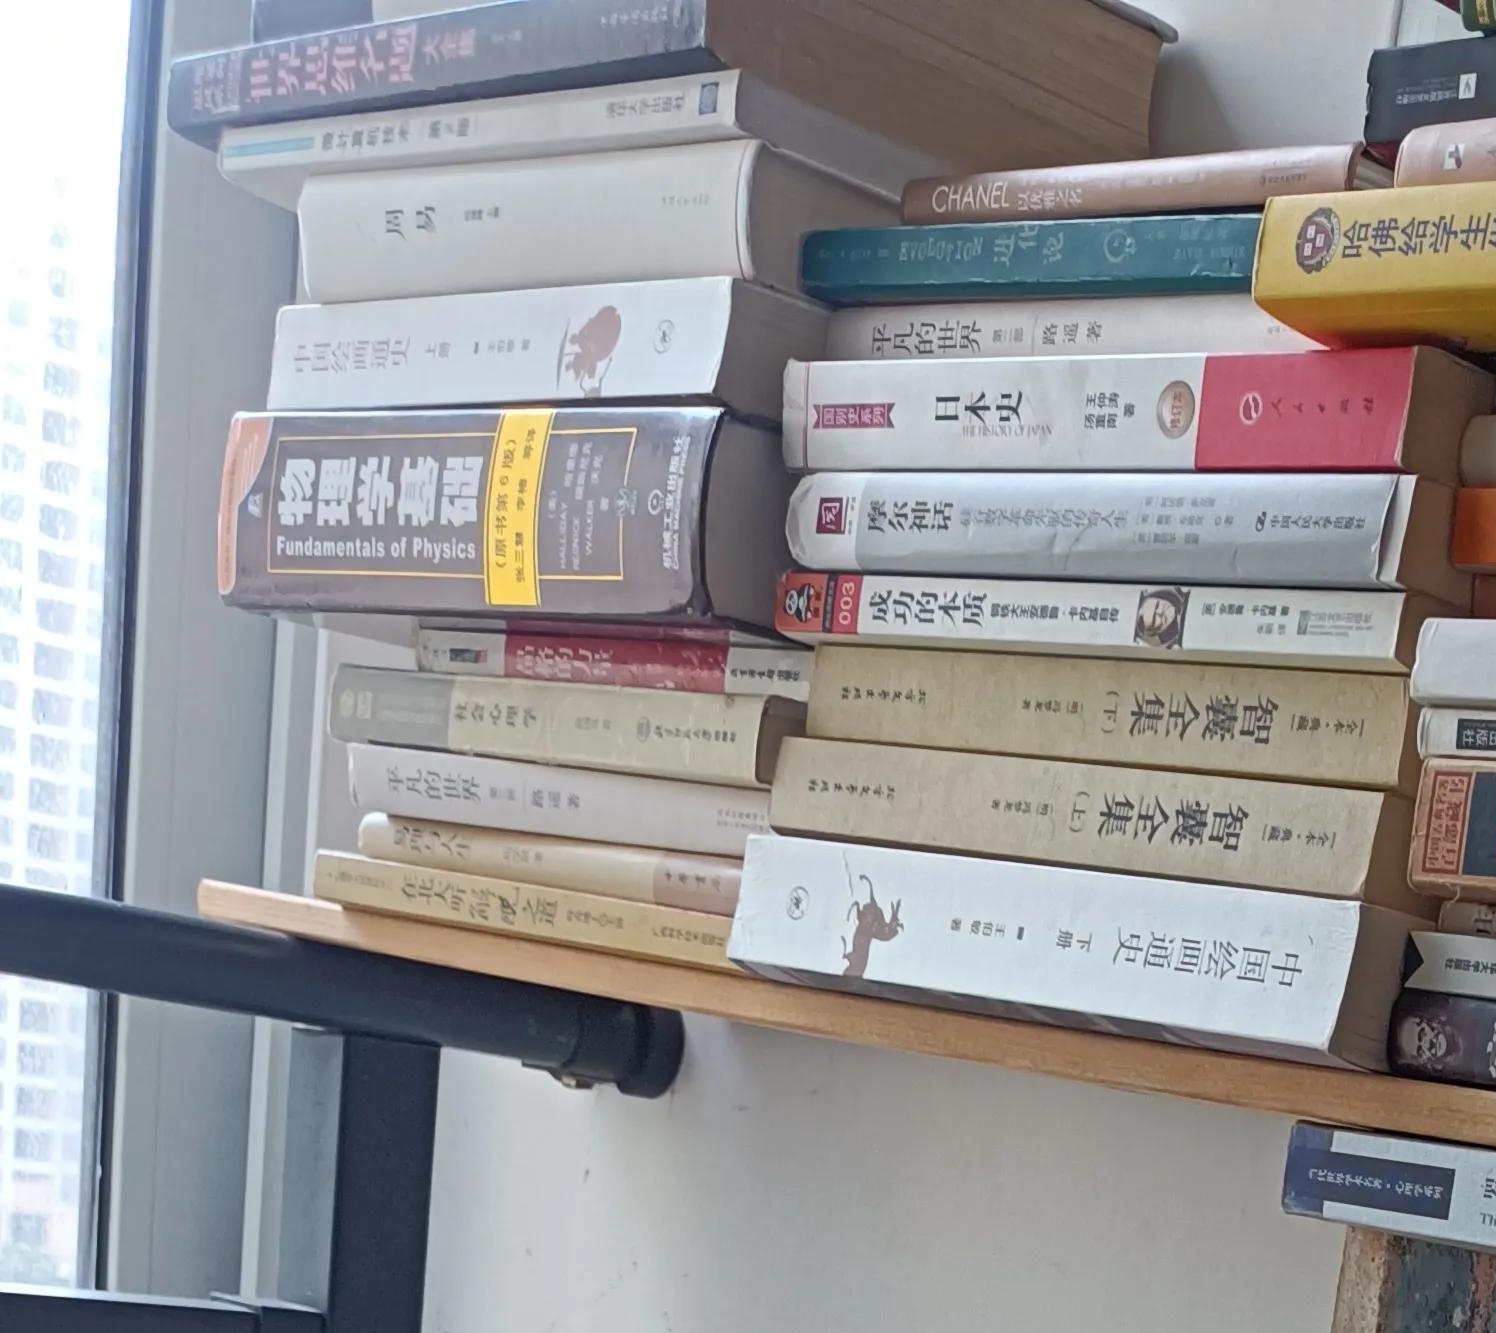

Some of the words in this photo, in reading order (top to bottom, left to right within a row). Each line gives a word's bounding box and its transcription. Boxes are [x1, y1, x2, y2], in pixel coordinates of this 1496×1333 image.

[932, 181, 1011, 213] CHANEL
[384, 205, 436, 241] 周易
[898, 237, 983, 263] EVOLUTION
[294, 337, 410, 374] 中国绘画通史
[871, 319, 983, 356] 平凡的世界
[1041, 321, 1080, 346] 路遥
[1086, 320, 1103, 344] 著
[821, 405, 887, 428] 国别史系列
[933, 390, 1023, 425] 日本史
[1123, 404, 1135, 419] 著
[277, 456, 484, 527] 物理学基础
[663, 436, 684, 569] 机械工业出版社
[866, 498, 955, 534] 摩尔神话
[276, 536, 385, 559] Fundamentals
[390, 537, 406, 558] of
[412, 537, 477, 562] Physics
[838, 582, 857, 626] 003
[869, 588, 989, 630] 成功的本质
[453, 703, 538, 730] 社会心理学
[1102, 689, 1121, 733] (下)
[1129, 692, 1281, 744] 智囊全集
[386, 766, 483, 803] 平凡的世界
[531, 789, 562, 810] 路遥
[566, 793, 581, 810] 著
[1068, 790, 1091, 834] (上)
[1098, 795, 1251, 853] 智囊全集
[400, 876, 559, 928] 在北大听解脱之道
[950, 919, 963, 932] 著
[968, 917, 1006, 938] 王伯敏
[1056, 928, 1092, 953] 下册
[1112, 925, 1303, 989] 中国绘画通史
